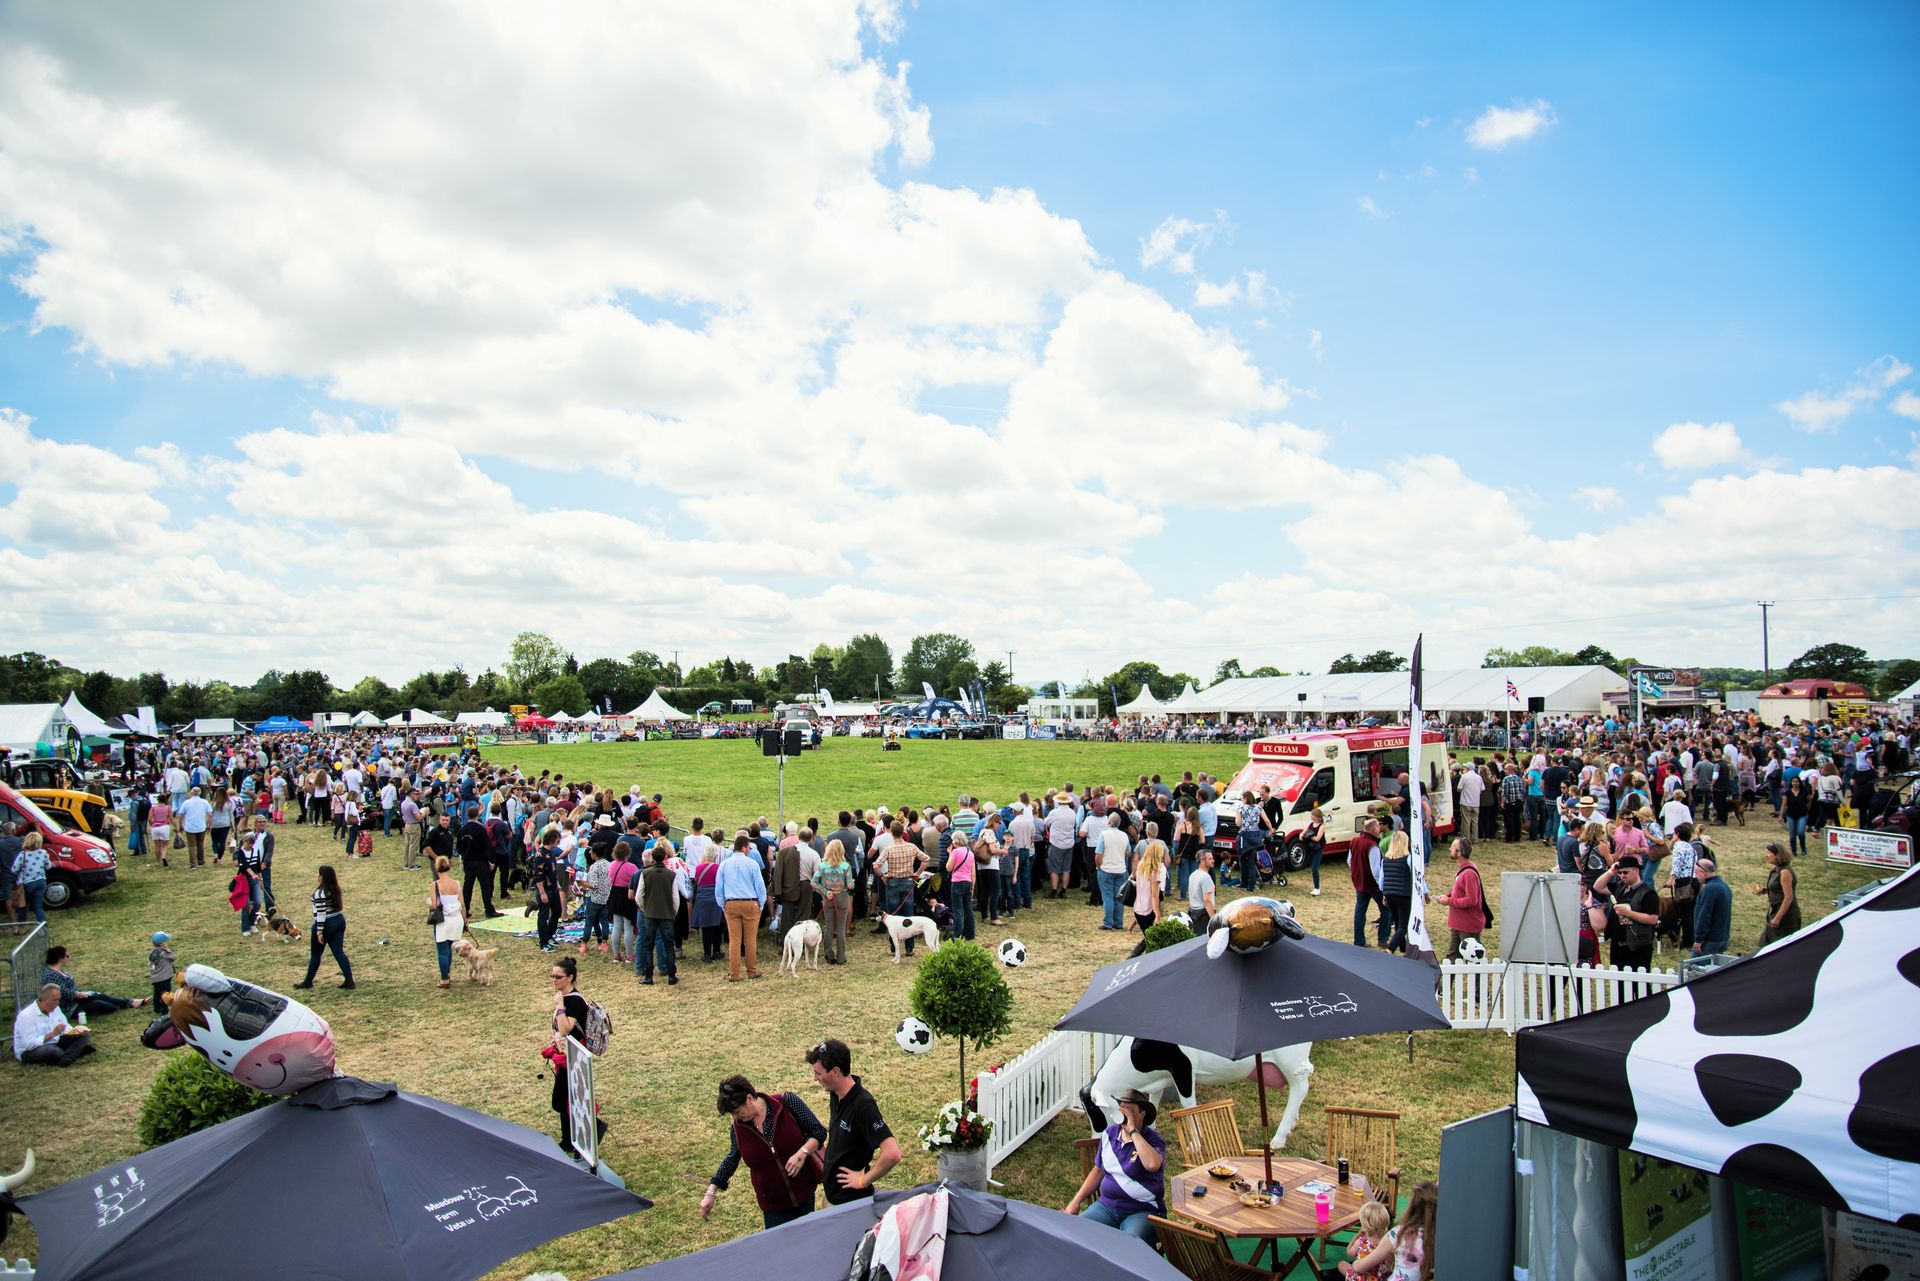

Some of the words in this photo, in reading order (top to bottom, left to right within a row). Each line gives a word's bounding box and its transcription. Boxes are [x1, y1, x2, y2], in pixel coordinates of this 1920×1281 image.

[1384, 738, 1404, 746] CREAM
[1262, 745, 1276, 753] ICE
[1277, 745, 1299, 754] CREAM
[1867, 836, 1896, 844] EQUIPMENT
[424, 1194, 465, 1212] Meadows
[435, 1210, 459, 1222] Farm
[445, 1220, 466, 1232] Vets
[1633, 1264, 1649, 1279] THE
[1656, 1233, 1696, 1265] INJECTABLE
